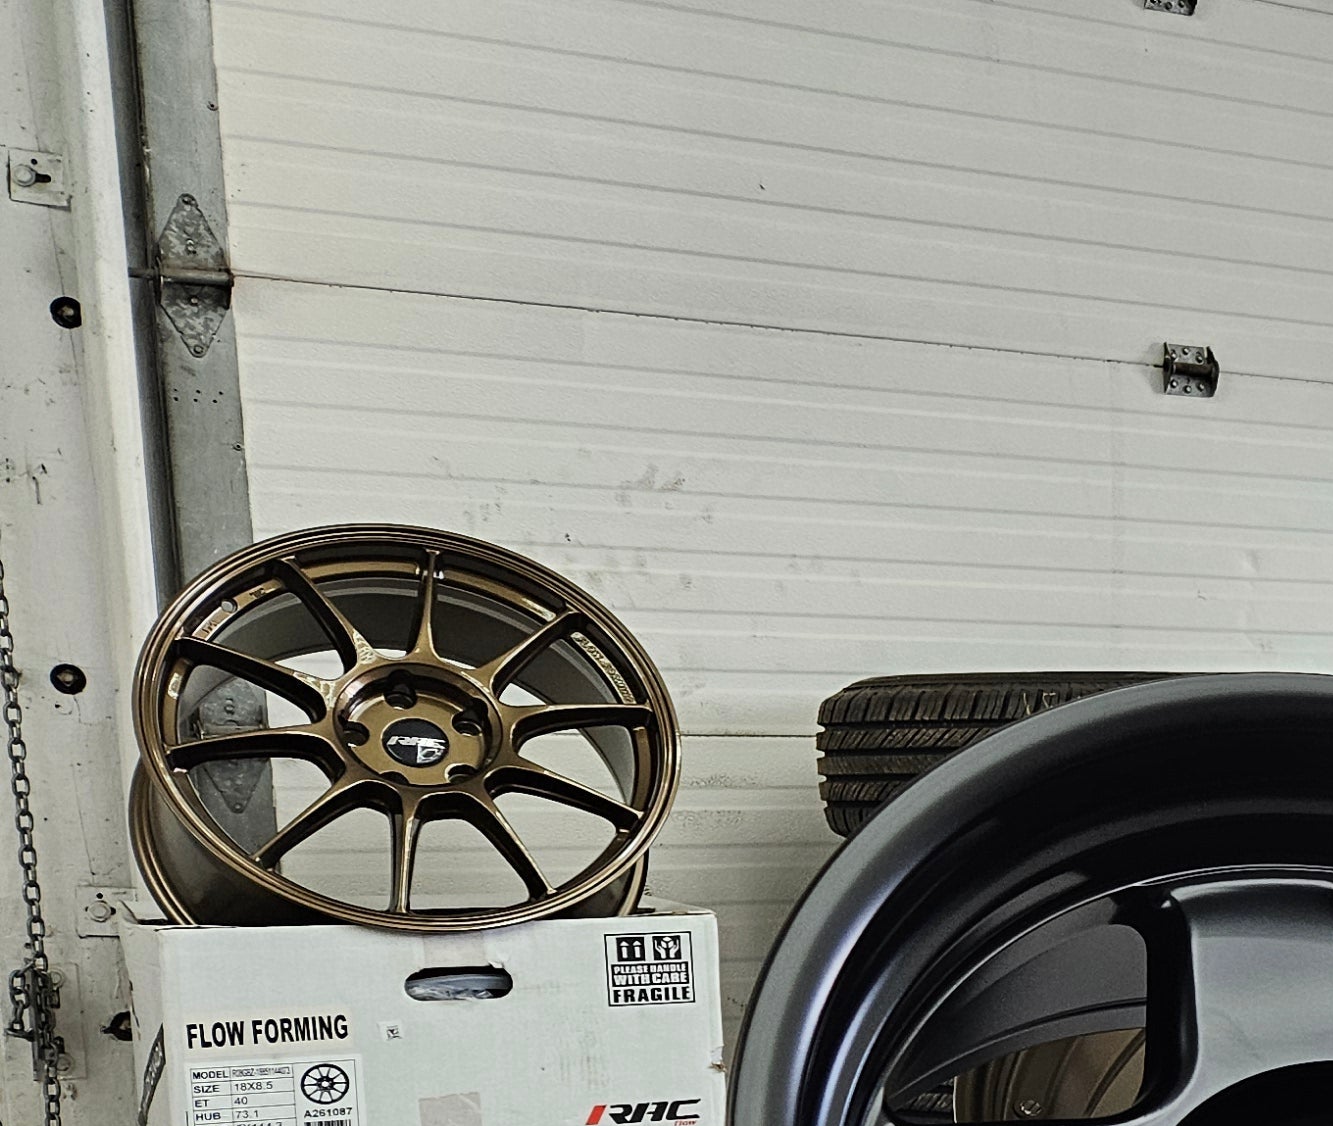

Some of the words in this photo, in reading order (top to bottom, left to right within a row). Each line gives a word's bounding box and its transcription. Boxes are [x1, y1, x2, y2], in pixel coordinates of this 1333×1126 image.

[614, 965, 649, 974] PLEASE
[650, 963, 686, 973] HANDLE
[613, 974, 650, 986] WITH
[651, 972, 688, 984] CARE
[613, 986, 690, 1003] FRAGILE
[186, 1021, 244, 1049] FLOW
[251, 1014, 348, 1044] FORMING
[192, 1070, 229, 1080] MODEL
[193, 1085, 220, 1094] SIZE
[234, 1081, 273, 1092] 18X8.5
[194, 1099, 210, 1108] ET
[233, 1096, 248, 1106] 40
[195, 1112, 222, 1121] HUB
[235, 1110, 259, 1119] 73.1
[303, 1107, 353, 1118] A261087
[609, 1098, 701, 1125] RAC
